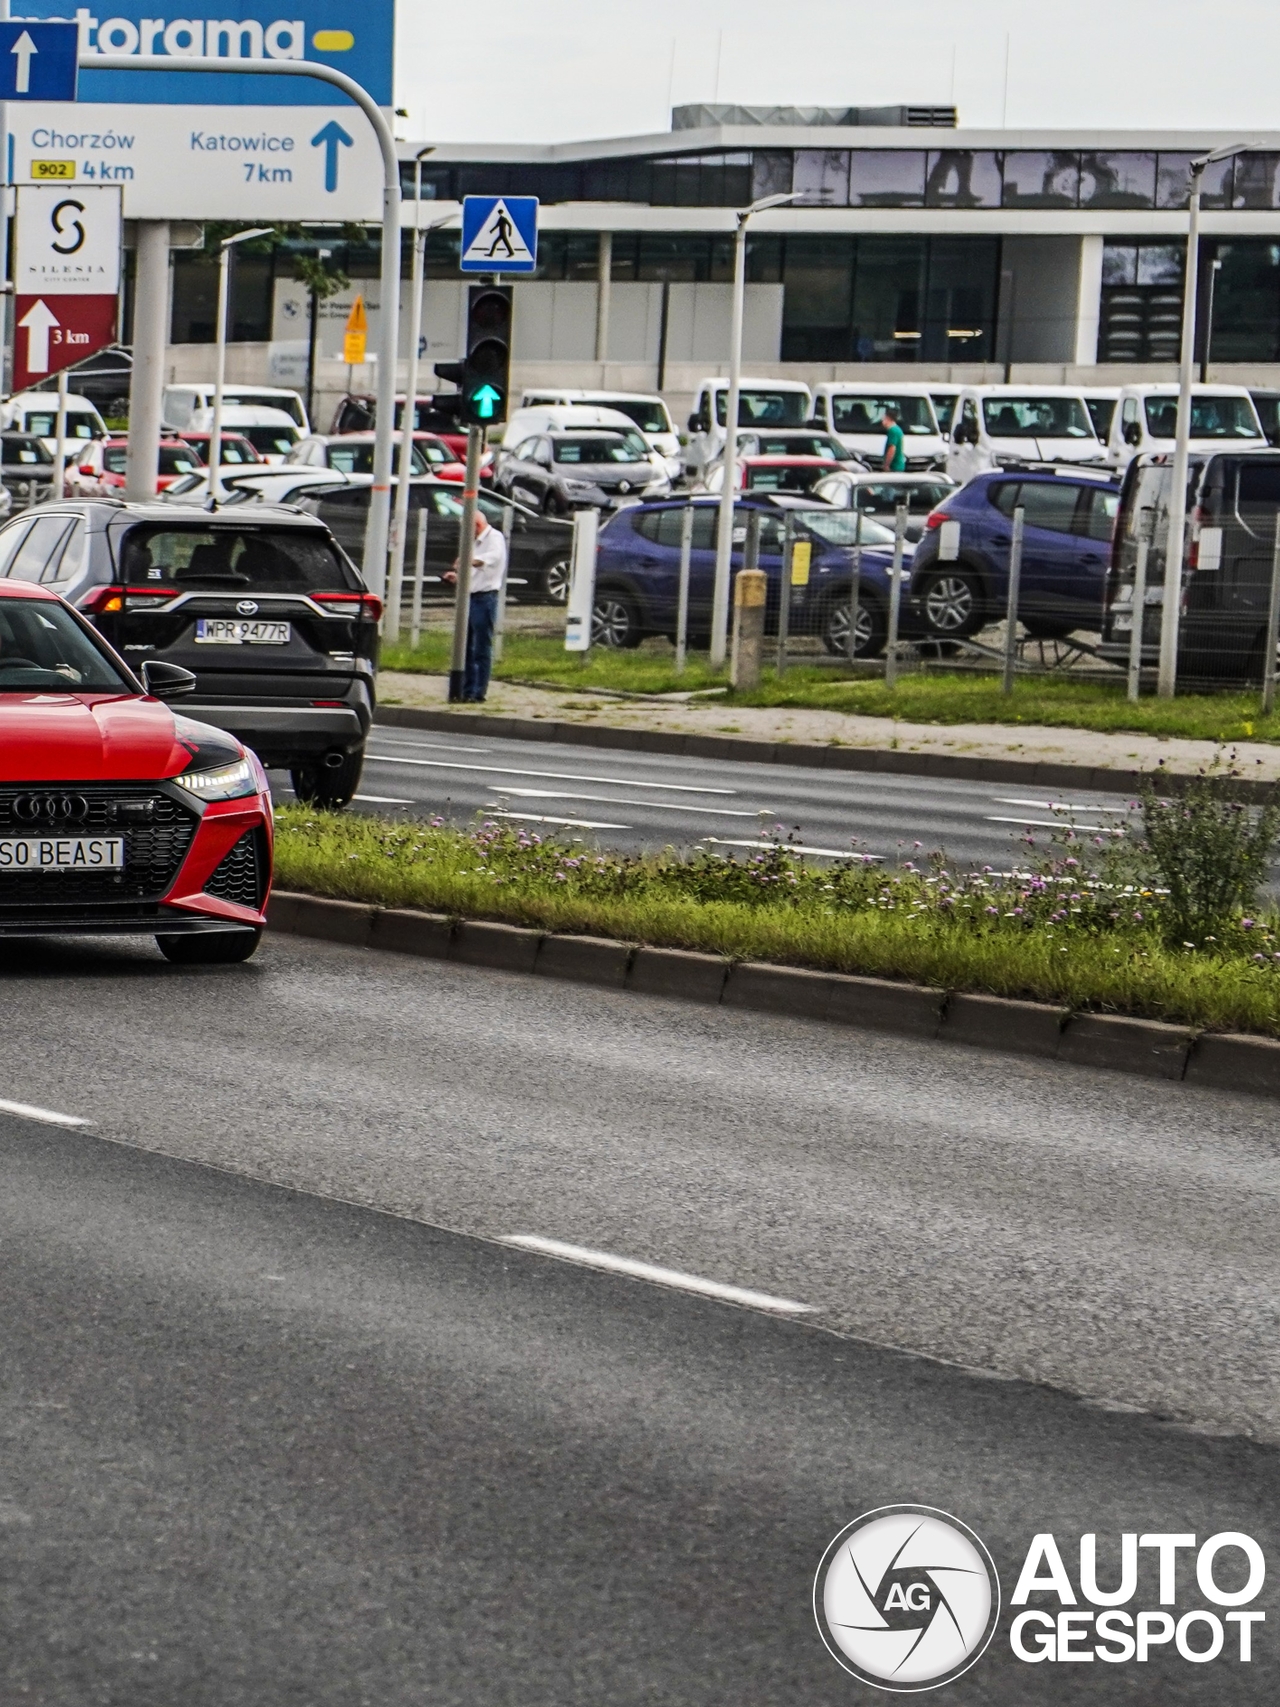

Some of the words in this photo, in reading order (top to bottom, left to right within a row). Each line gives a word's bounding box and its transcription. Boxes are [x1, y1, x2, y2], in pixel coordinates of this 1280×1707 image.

[32, 128, 135, 149] Chorzów
[191, 131, 295, 151] Katowice
[38, 163, 67, 176] 902
[29, 265, 106, 274] SILESIA
[53, 329, 63, 345] 3
[66, 329, 90, 345] km
[205, 621, 234, 638] WPR
[241, 622, 289, 640] 9477R
[39, 840, 119, 866] BEAST
